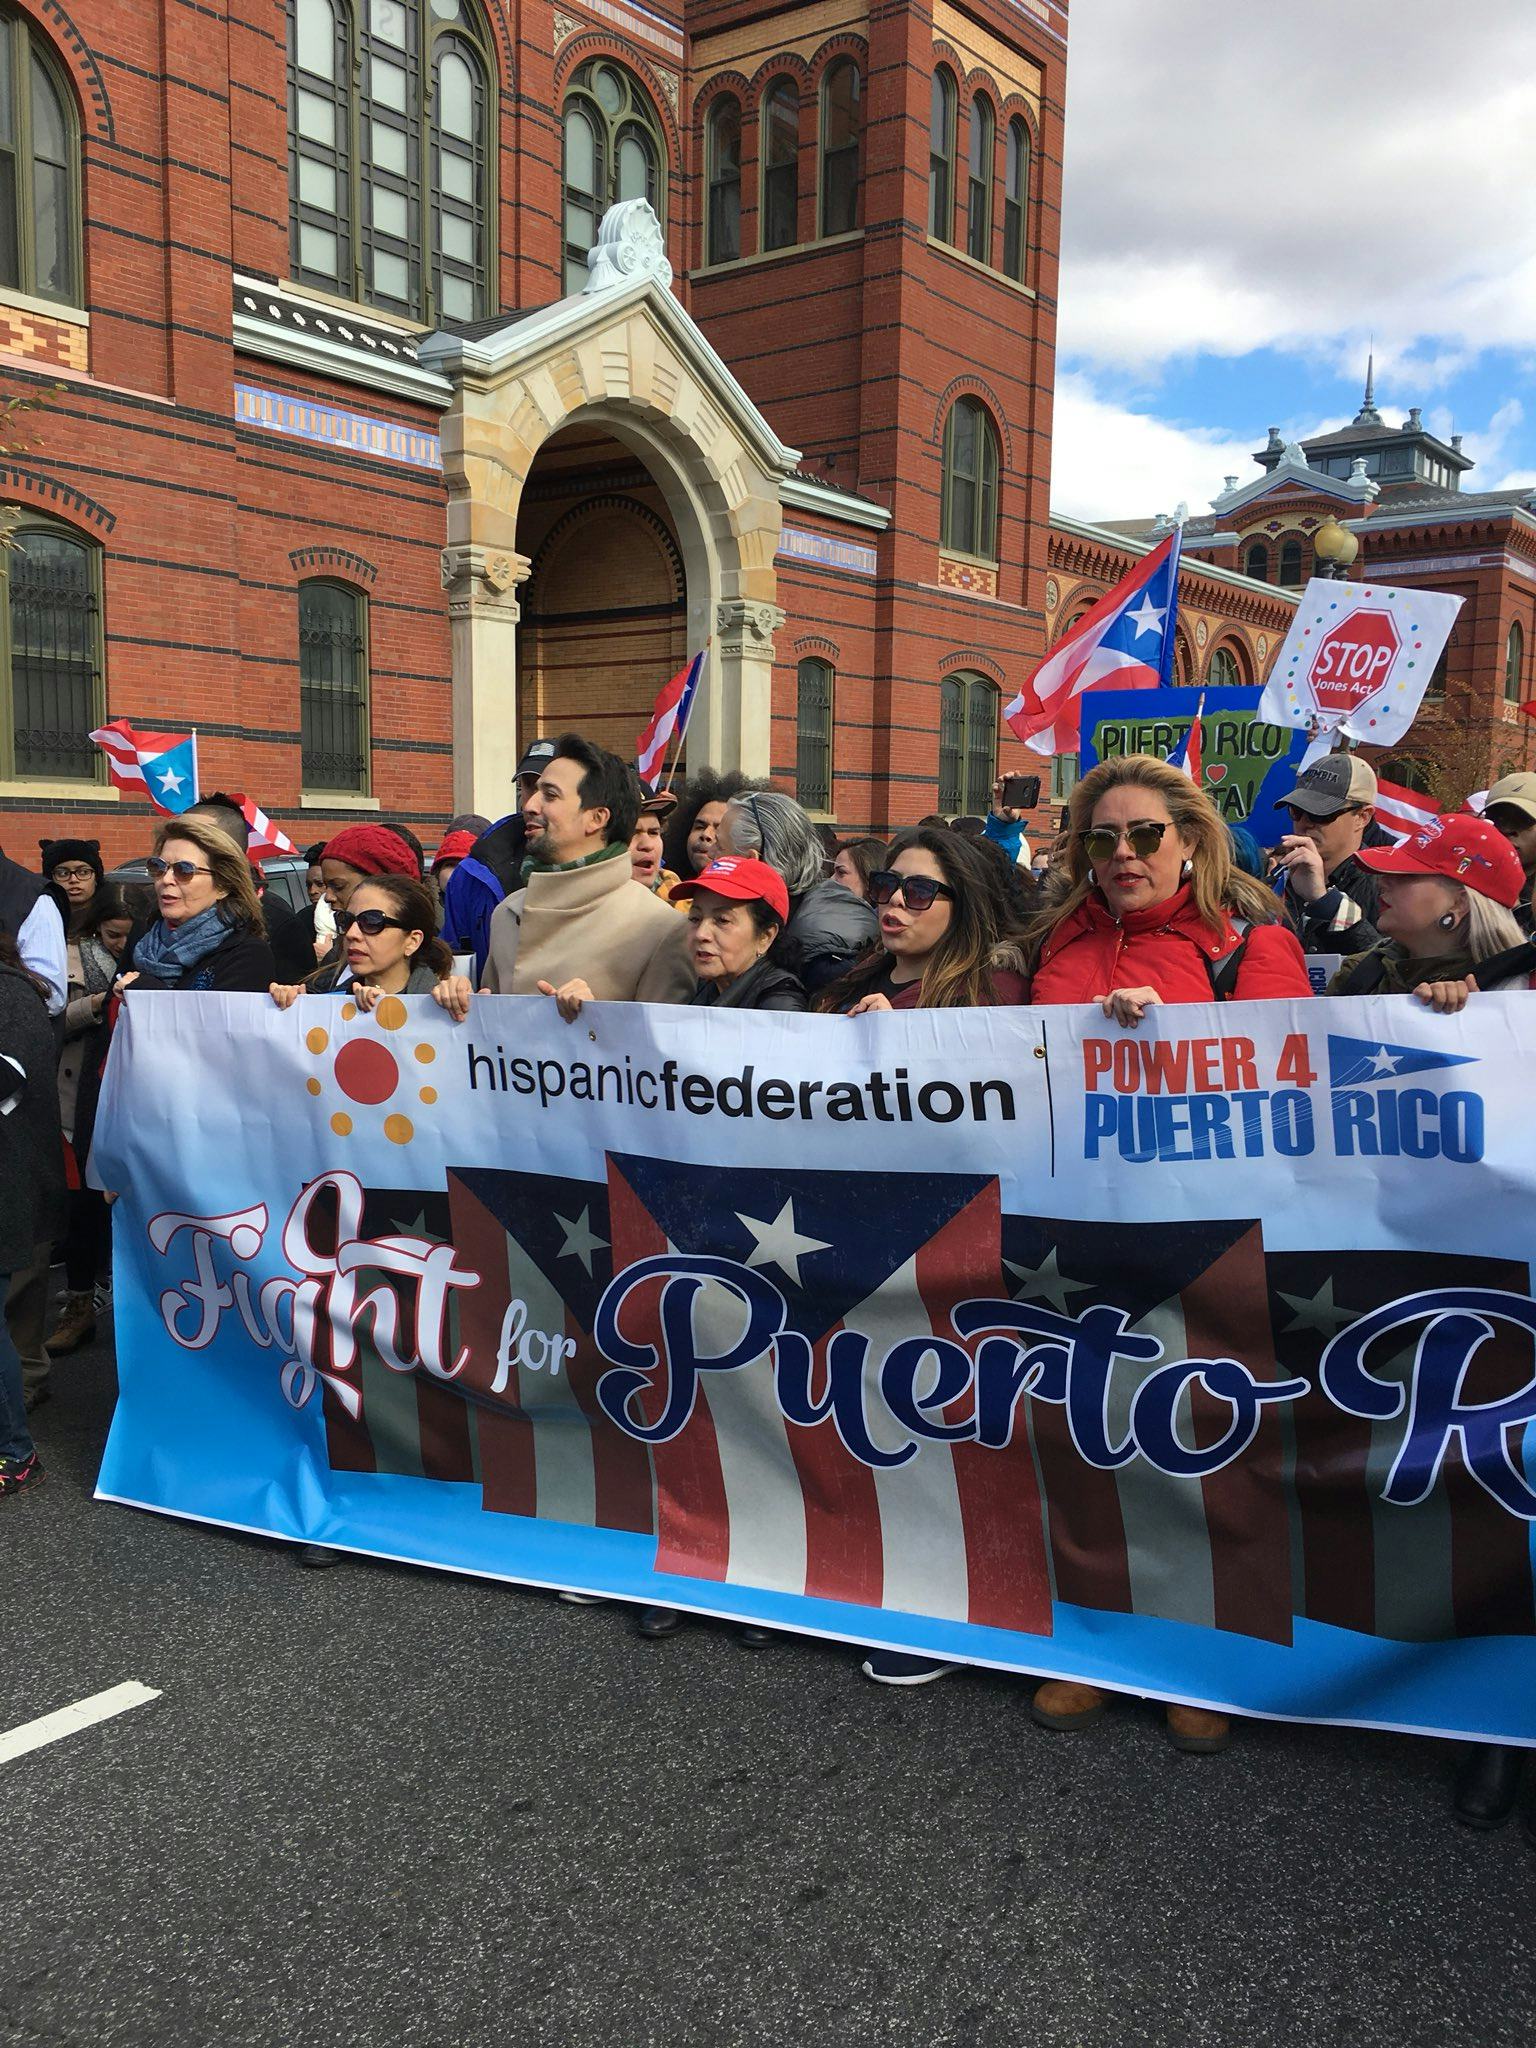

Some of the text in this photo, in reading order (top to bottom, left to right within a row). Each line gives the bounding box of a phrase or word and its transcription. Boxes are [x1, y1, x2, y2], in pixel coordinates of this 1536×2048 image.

[1314, 678, 1374, 695] Jones Act
[1315, 640, 1392, 681] STOP
[1215, 721, 1282, 760] RICO
[467, 1043, 1017, 1123] hispanicfederation
[1083, 1033, 1318, 1095] POWER 4
[1083, 1088, 1485, 1164] PUERTO RICO
[147, 1169, 481, 1422] Fight
[490, 1298, 577, 1393] for
[594, 1253, 1311, 1479] Puerto
